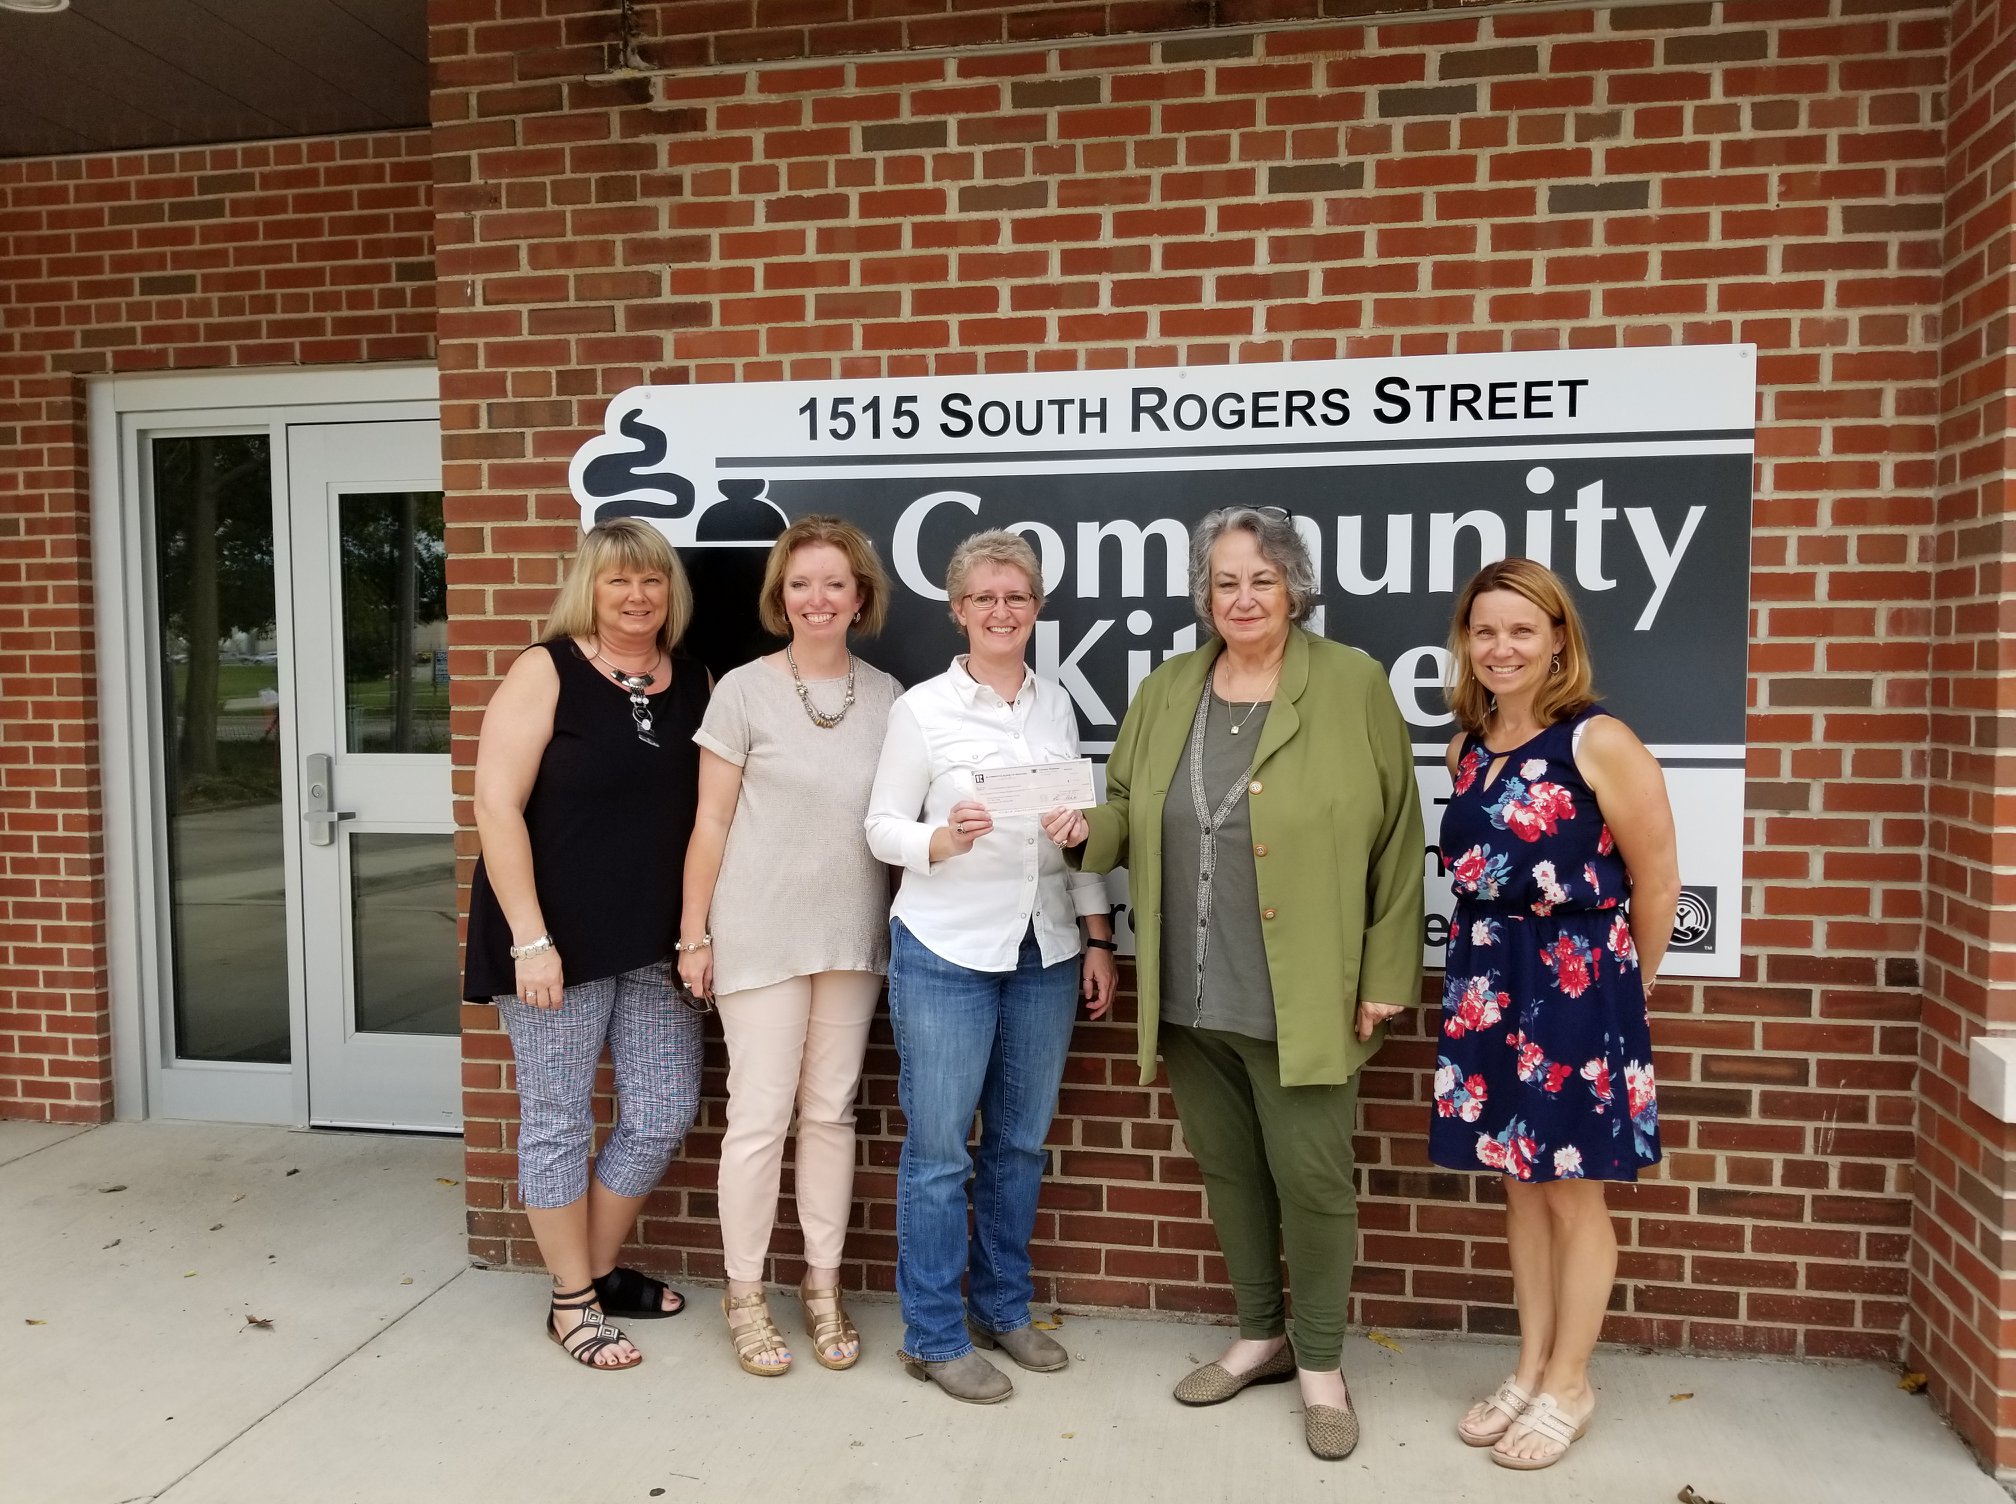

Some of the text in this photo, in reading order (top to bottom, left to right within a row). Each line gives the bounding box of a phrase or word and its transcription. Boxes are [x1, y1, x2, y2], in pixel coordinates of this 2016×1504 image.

[799, 376, 1589, 441] 1515 SOUTH ROGERS STREET
